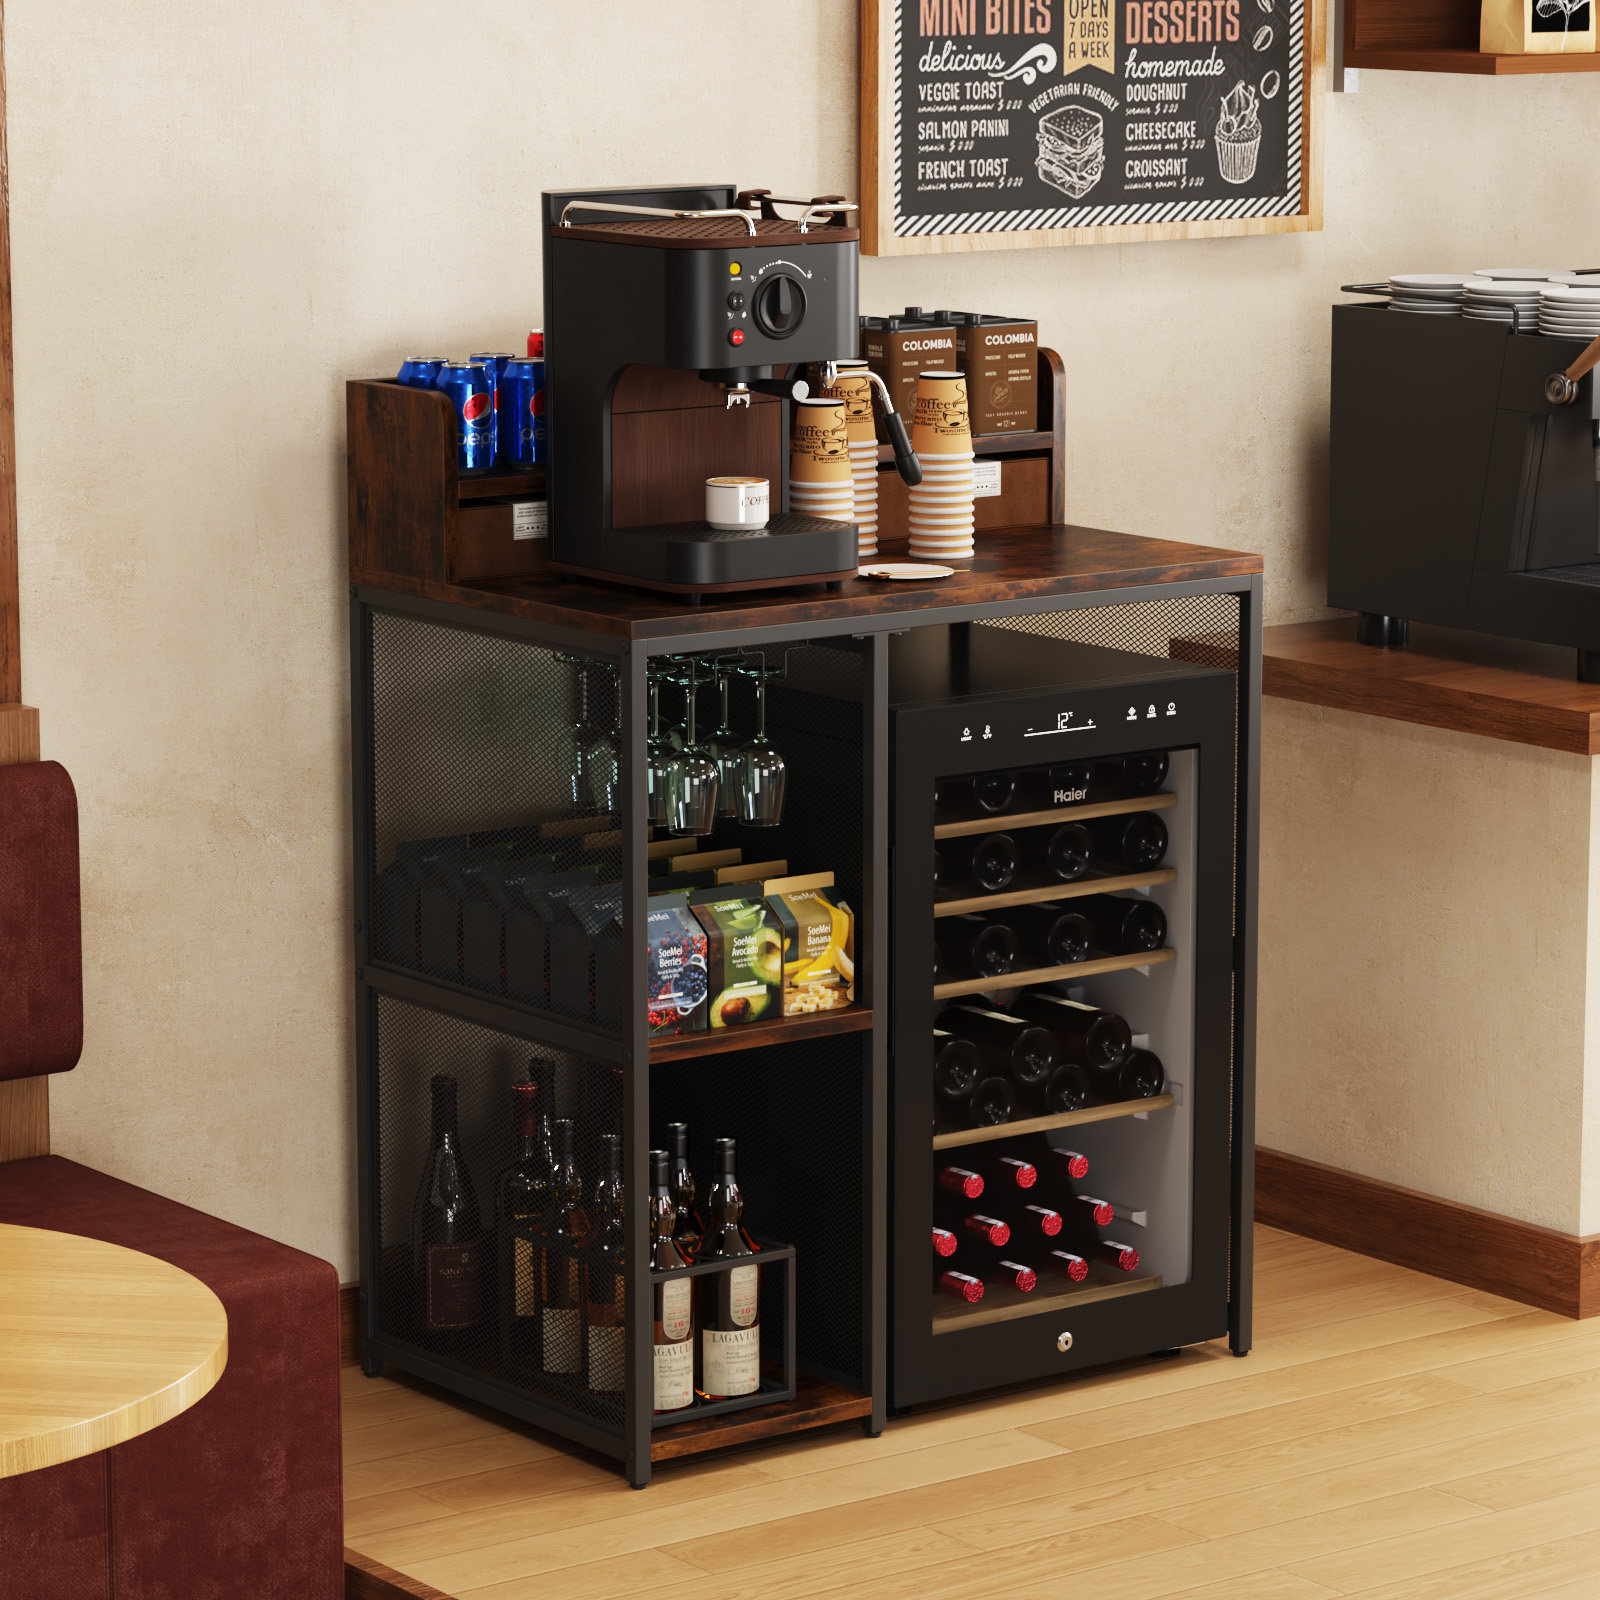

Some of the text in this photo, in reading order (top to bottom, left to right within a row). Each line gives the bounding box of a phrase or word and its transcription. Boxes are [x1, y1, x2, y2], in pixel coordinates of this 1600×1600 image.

[1069, 0, 1109, 19] OPEN
[919, 0, 1051, 37] MINI BITES
[1125, 0, 1240, 44] DESSERTS
[1069, 21, 1109, 39] 7 DAYS
[918, 40, 1006, 72] delicious
[1068, 40, 1110, 59] A WEEK
[1124, 45, 1226, 79] homemade
[918, 81, 1005, 102] VEGGIE TOAST
[1028, 82, 1120, 114] VEGETARIAN FRIENDLY
[1126, 82, 1188, 102] DOUGHNUT
[917, 118, 1009, 140] SALMON PANINI
[1125, 120, 1197, 142] CHEESECAKE
[917, 157, 1009, 180] FRENCH TOAST
[1125, 157, 1188, 178] CROISSANT
[902, 338, 953, 352] COLOMBIA
[985, 332, 1035, 346] COLOMBIA
[820, 386, 854, 398] offee
[1054, 788, 1087, 804] Haier
[788, 890, 818, 902] SoeMei
[714, 901, 745, 913] SoeMei
[647, 911, 671, 923] oeMei
[807, 923, 831, 936] SoeMei
[733, 934, 757, 947] SoeMei
[807, 935, 832, 946] Banana
[658, 945, 683, 958] SoeMei
[731, 945, 759, 958] Avocado
[659, 957, 682, 968] Berries
[653, 1343, 689, 1357] AGAVUL
